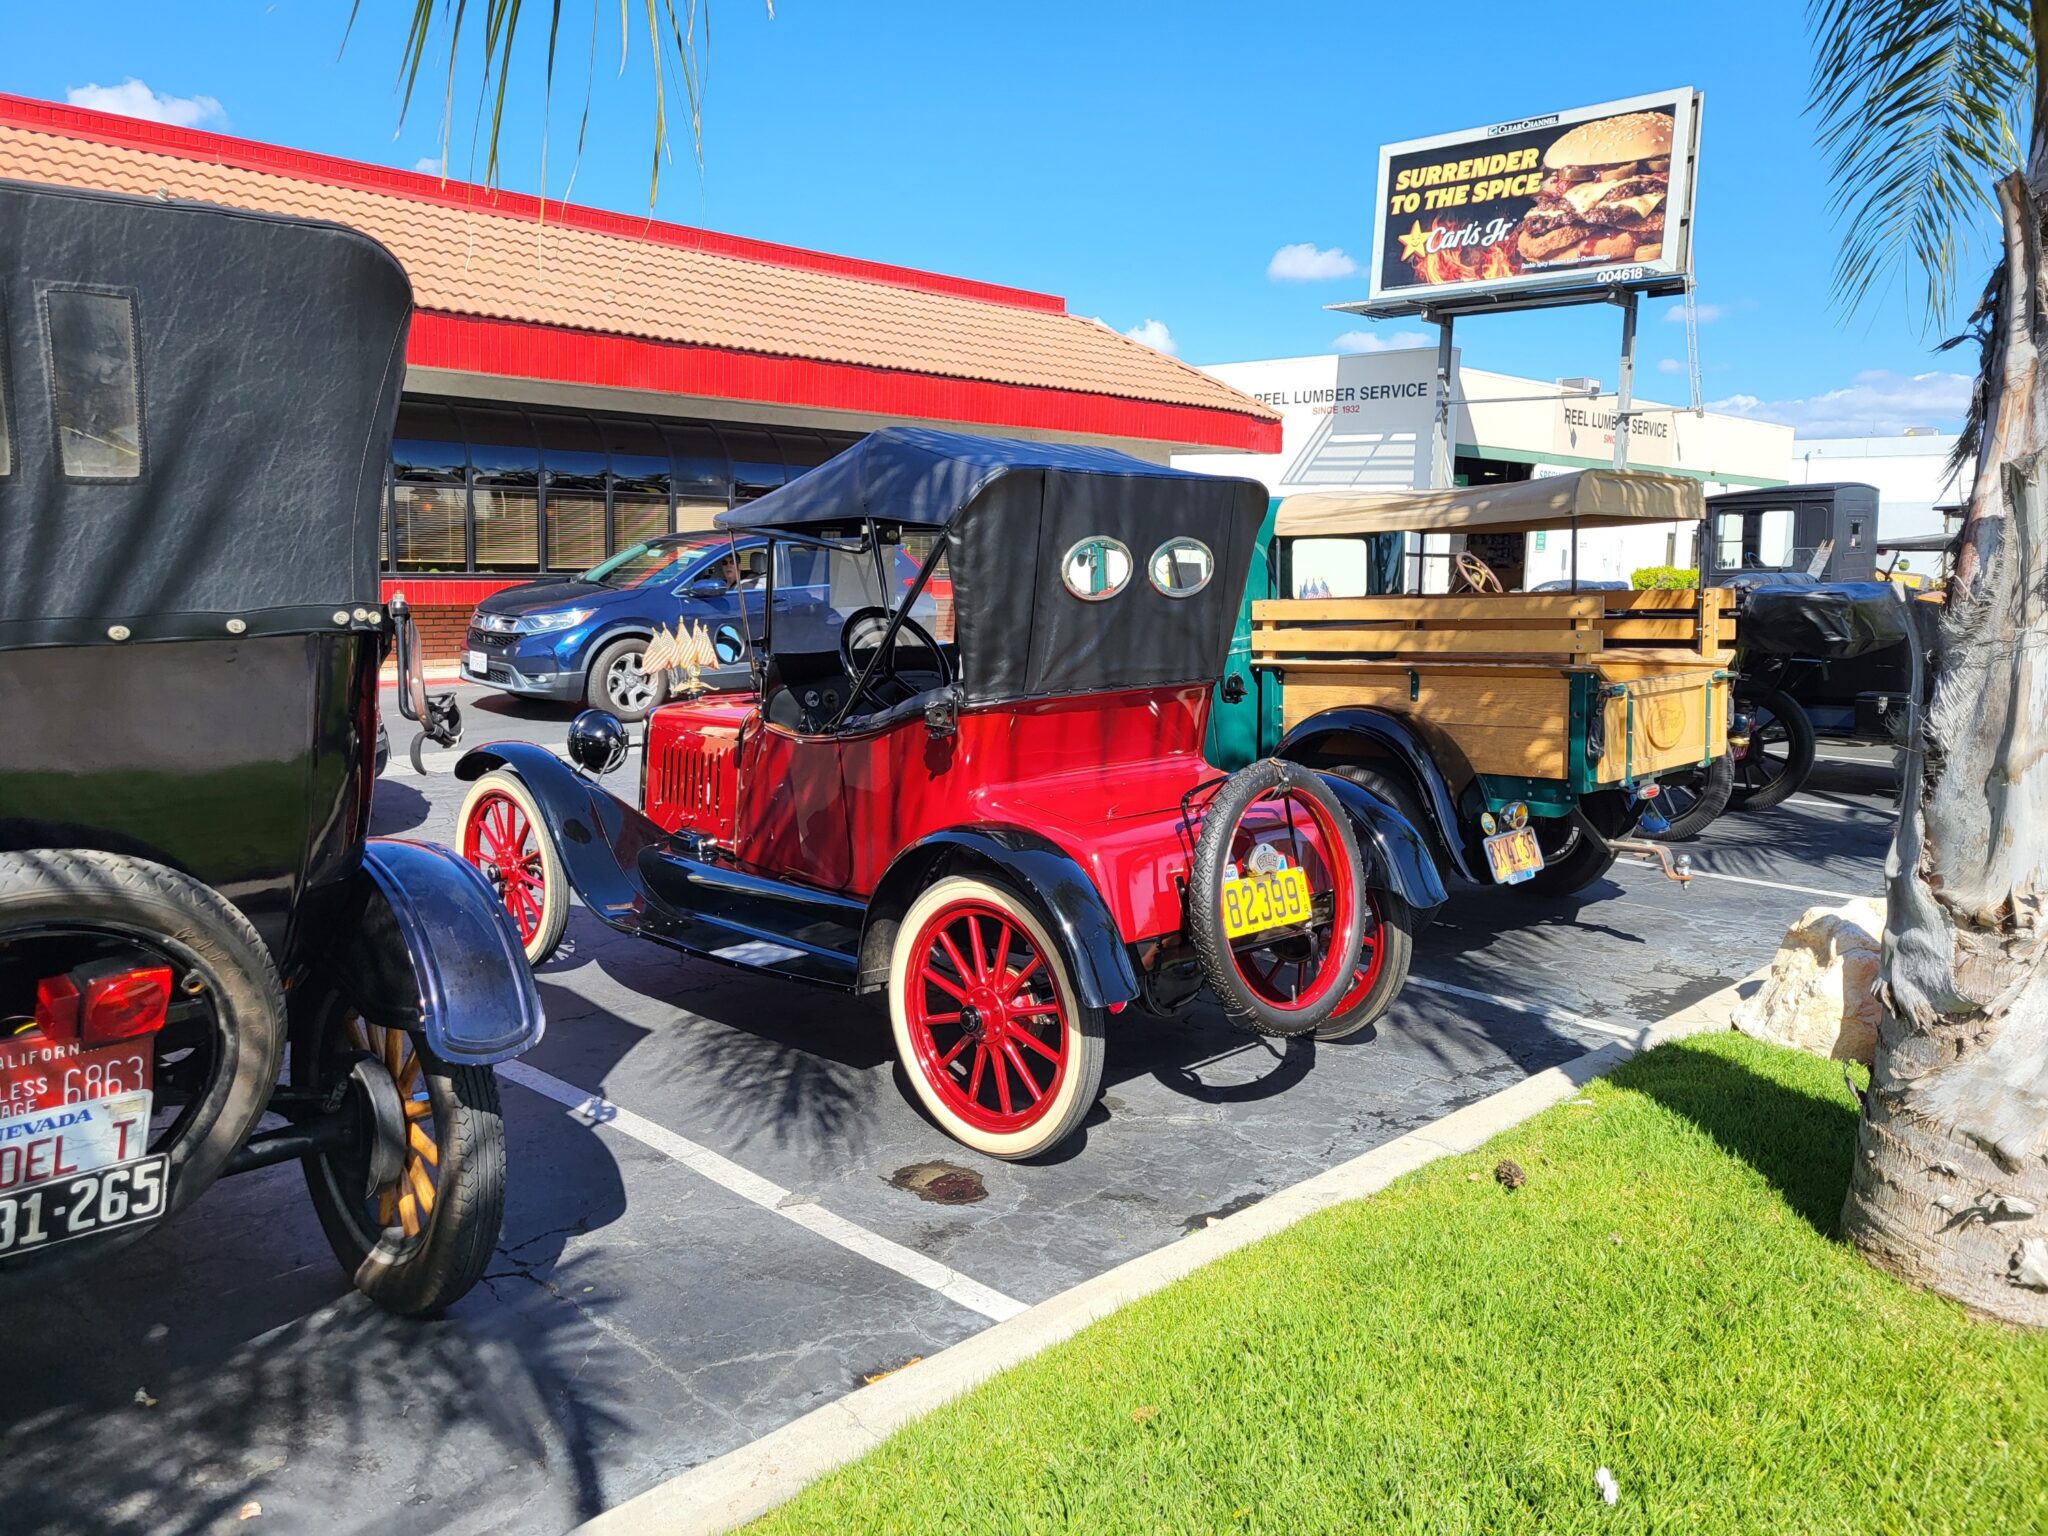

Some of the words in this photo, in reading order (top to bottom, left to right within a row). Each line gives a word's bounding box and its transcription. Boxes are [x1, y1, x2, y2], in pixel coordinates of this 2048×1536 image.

[1395, 148, 1540, 191] SURRENDER
[1391, 192, 1421, 215] TO
[1424, 184, 1470, 211] THE
[1471, 172, 1543, 204] SPICE
[1425, 221, 1482, 253] Carl's
[1481, 217, 1514, 247] Jr.
[1597, 268, 1643, 283] 004618
[1294, 388, 1355, 404] LUMBER
[1359, 382, 1428, 401] SERVICE
[1312, 405, 1338, 415] SINCE
[1342, 404, 1360, 414] 1932
[1564, 408, 1589, 427] REEL
[1592, 411, 1620, 431] LUMB
[1632, 418, 1668, 438] SERVICE
[1603, 434, 1617, 444] SINC
[1226, 877, 1301, 929] 82399
[0, 1042, 92, 1070] ALIFORN
[64, 1055, 144, 1105] 6863
[0, 1135, 78, 1190] DEL
[113, 1118, 137, 1160] T
